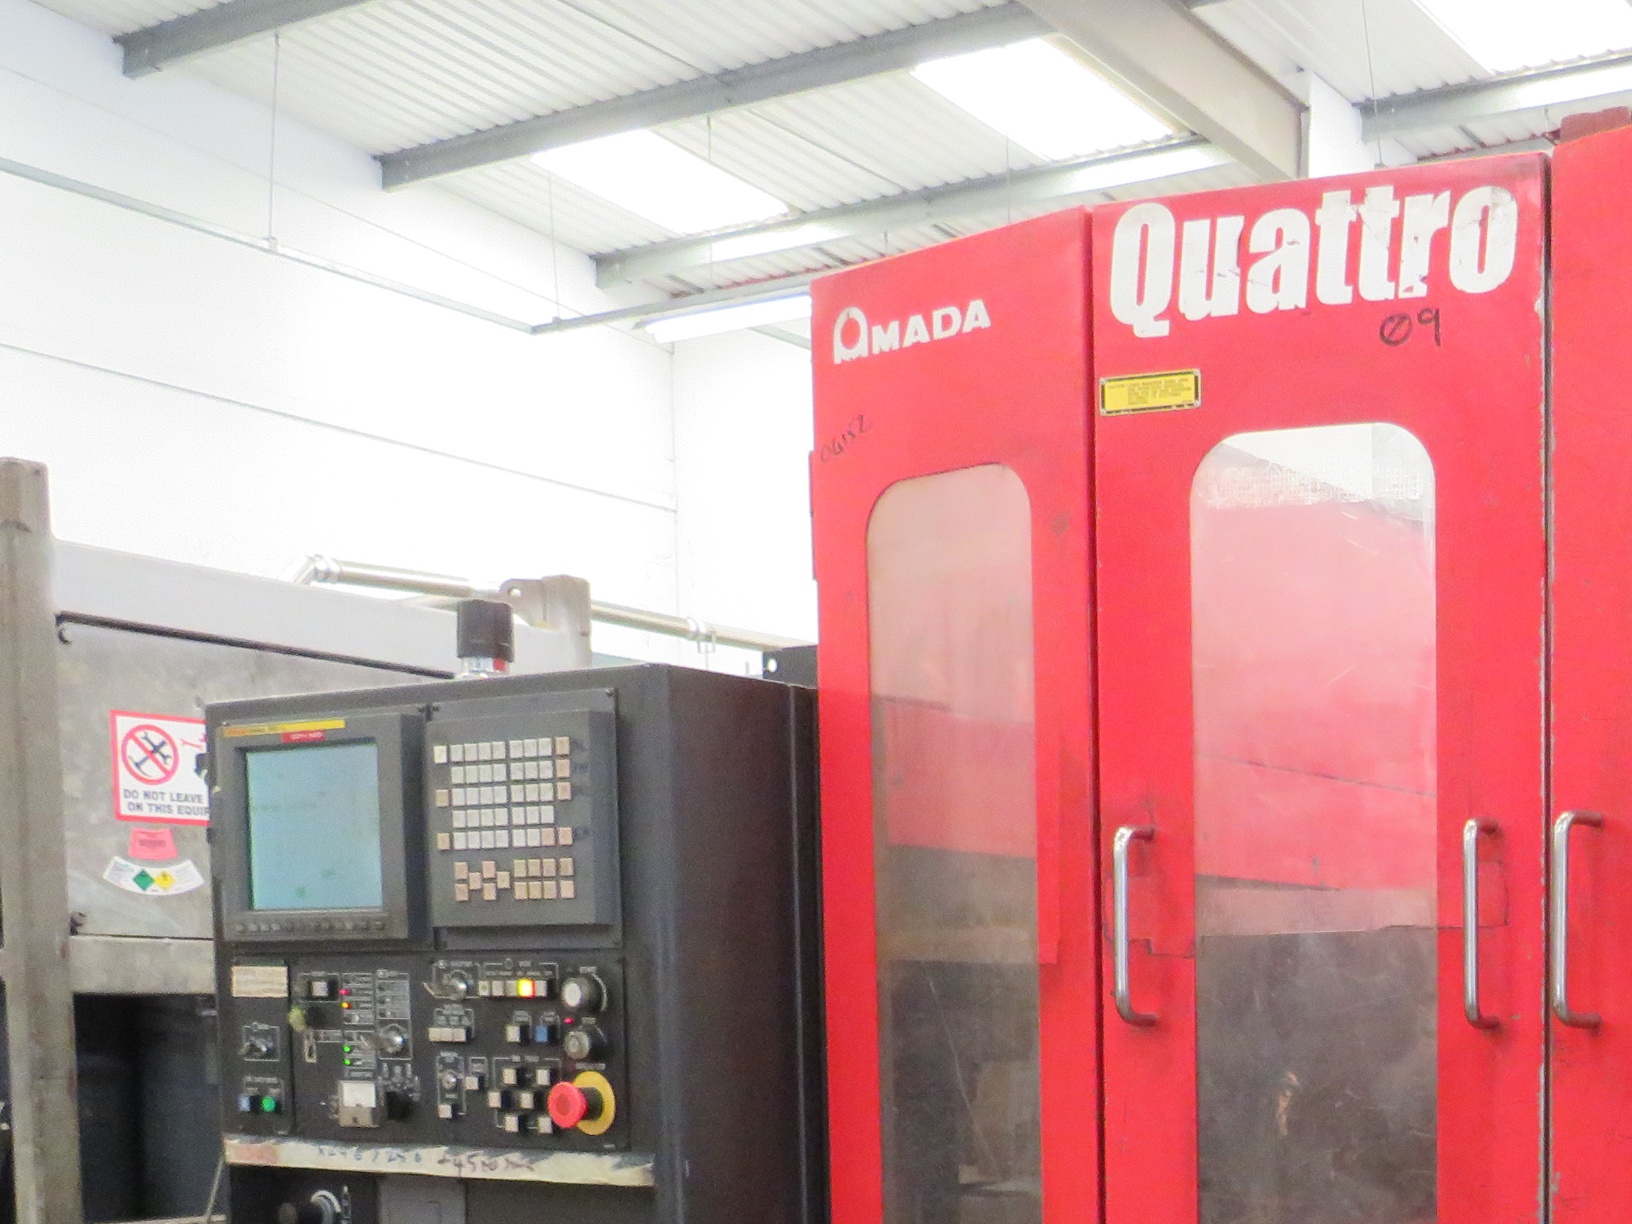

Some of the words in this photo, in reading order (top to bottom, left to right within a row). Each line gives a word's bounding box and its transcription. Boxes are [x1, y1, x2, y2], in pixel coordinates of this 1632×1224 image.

[1109, 184, 1518, 339] Quattro
[123, 788, 139, 799] DO
[142, 790, 165, 801] NOT
[169, 792, 204, 804] LEAVE
[127, 801, 143, 812] ON
[147, 803, 174, 815] THIS
